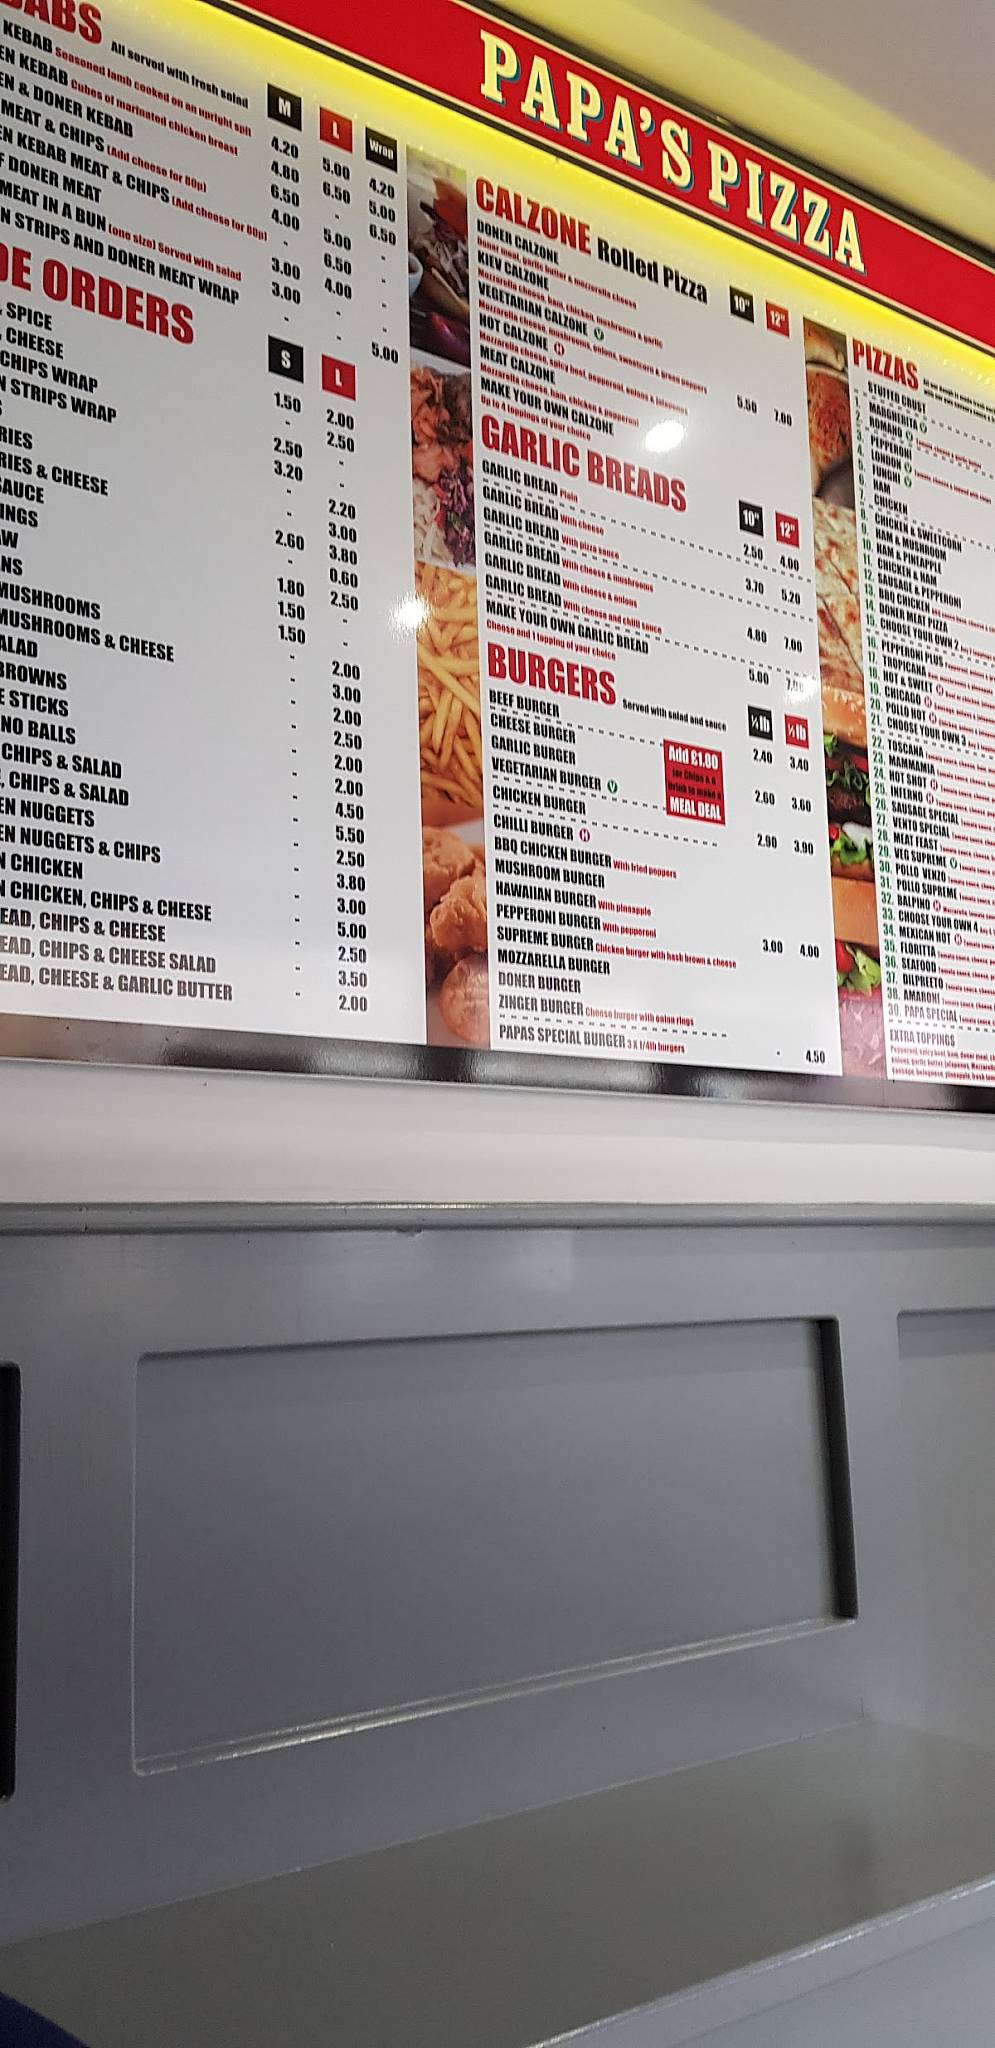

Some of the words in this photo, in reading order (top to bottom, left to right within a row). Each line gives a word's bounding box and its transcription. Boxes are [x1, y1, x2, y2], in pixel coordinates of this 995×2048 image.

[3, 20, 52, 53] KEBAB
[55, 47, 105, 76] Seasoned
[108, 69, 131, 88] lamb
[134, 82, 169, 102] cooked
[172, 97, 183, 107] on
[186, 102, 197, 113] an
[199, 105, 232, 129] upright
[235, 121, 252, 137] spit
[111, 41, 125, 56] All
[128, 49, 164, 73] served
[167, 65, 189, 83] with
[192, 75, 218, 96] fresh
[221, 87, 248, 109] salad
[20, 52, 68, 86] KEBAB
[71, 79, 103, 100] Cubes
[105, 93, 114, 105] of
[116, 99, 167, 127] marinated
[169, 118, 206, 143] chicken
[208, 135, 238, 156] breast
[34, 84, 82, 118] DONER
[86, 105, 133, 138] KEBAB
[279, 98, 290, 118] M
[1, 99, 41, 130] MEAT
[45, 119, 56, 133] &
[60, 122, 104, 152] CHIPS
[132, 155, 167, 176] cheese
[170, 166, 183, 183] for
[333, 121, 340, 140] L
[369, 138, 394, 160] Wrap
[480, 29, 693, 188] PAPA'S
[708, 139, 867, 275] PIZZA
[271, 135, 298, 159] 4.20
[323, 157, 350, 179] 5.00
[369, 177, 395, 199] 4.20
[271, 160, 299, 183] 4.80
[323, 181, 350, 204] 6.50
[369, 200, 395, 223] 5.00
[0, 180, 40, 208] MEAT
[43, 195, 58, 215] IN
[62, 202, 72, 220] A
[76, 207, 106, 232] BUN
[108, 224, 131, 241] (one
[133, 233, 155, 250] size)
[158, 243, 192, 263] Served
[194, 257, 214, 271] with
[216, 265, 241, 281] salad
[476, 177, 591, 256] CALZONE
[597, 237, 659, 284] Rolled
[663, 265, 708, 304] Pizza
[477, 219, 512, 245] DONER
[515, 236, 559, 265] CALZONE
[15, 213, 69, 245] STRIPS
[73, 233, 104, 257] AND
[108, 244, 155, 276] DONER
[159, 264, 195, 290] MEAT
[199, 279, 239, 306] WRAP
[477, 250, 502, 272] KIEV
[504, 263, 549, 292] CALZONE
[43, 258, 193, 344] ORDERS
[478, 281, 542, 317] VEGETARIAN
[545, 307, 588, 336] CALZONE
[6, 302, 52, 331] SPICE
[1, 350, 48, 379] CHIPS
[52, 366, 98, 394] WRAP
[281, 350, 290, 369] S
[853, 338, 918, 391] PIZZAS
[336, 369, 342, 387] L
[274, 392, 300, 413] 1.50
[326, 409, 354, 430] 2.00
[481, 376, 511, 399] MAKE
[514, 388, 541, 410] YOUR
[545, 399, 569, 419] OWN
[571, 410, 614, 436] CALZONE
[737, 394, 757, 414] 5.50
[481, 395, 490, 406] Up
[492, 399, 499, 410] to
[508, 403, 539, 423] toppings
[541, 416, 549, 425] of
[550, 420, 565, 432] your
[567, 425, 591, 441] choice
[274, 460, 303, 482] 3.20
[481, 414, 580, 477] GARLIC
[588, 449, 686, 512] BREADS
[871, 449, 901, 470] LONDON
[482, 459, 521, 484] GARLIC
[524, 472, 558, 495] BREAD
[560, 488, 577, 503] Plain
[873, 479, 890, 495] HAM
[874, 494, 907, 515] CHICKEN
[743, 509, 759, 526] 10"
[780, 521, 795, 538] 12"
[876, 528, 893, 542] HAM
[743, 544, 763, 560] 2.50
[780, 555, 799, 572] 4.00
[882, 654, 926, 676] TROPICANA
[488, 642, 616, 705] BURGERS
[623, 699, 649, 714] Served
[651, 704, 666, 719] with
[669, 708, 688, 722] salad
[690, 712, 704, 725] and
[705, 716, 727, 732] sauce
[9, 690, 69, 717] STICKS
[489, 689, 514, 708] BEEF
[517, 694, 559, 718] BURGER
[28, 720, 75, 745] BALLS
[669, 745, 688, 765] Add
[753, 749, 772, 764] 2.40
[790, 757, 809, 772] 3.40
[889, 754, 935, 775] MAMMAMIA
[889, 770, 905, 783] HOT
[907, 774, 927, 789] SHOT
[20, 800, 94, 827] NUGGETS
[670, 796, 696, 816] MEAL
[698, 803, 721, 820] DEAL
[336, 825, 364, 844] 5.50
[894, 832, 913, 846] MEAT
[916, 837, 938, 850] FEAST
[10, 853, 83, 879] CHICKEN
[894, 848, 910, 860] VEG
[912, 851, 946, 868] SUPREME
[496, 881, 551, 902] HAWAIIAN
[554, 887, 596, 909] BURGER
[598, 899, 615, 911] With
[616, 901, 651, 917] pineapple
[497, 925, 549, 946] SUPREME
[551, 933, 593, 952] BURGER
[763, 939, 783, 953] 3.00
[800, 944, 819, 958] 4.00
[901, 941, 935, 957] FLORITTA
[902, 957, 936, 973] SEAFOOD
[39, 967, 99, 989] CHEESE
[118, 975, 173, 996] GARLIC
[177, 980, 233, 1001] BUTTER
[339, 995, 368, 1012] 2.00
[500, 1024, 534, 1042] PAPAS
[538, 1028, 581, 1045] SPECIAL
[584, 1033, 625, 1048] BURGER
[890, 1029, 915, 1043] EXTRA
[917, 1030, 955, 1047] TOPPINGS
[806, 1050, 825, 1063] 4.50
